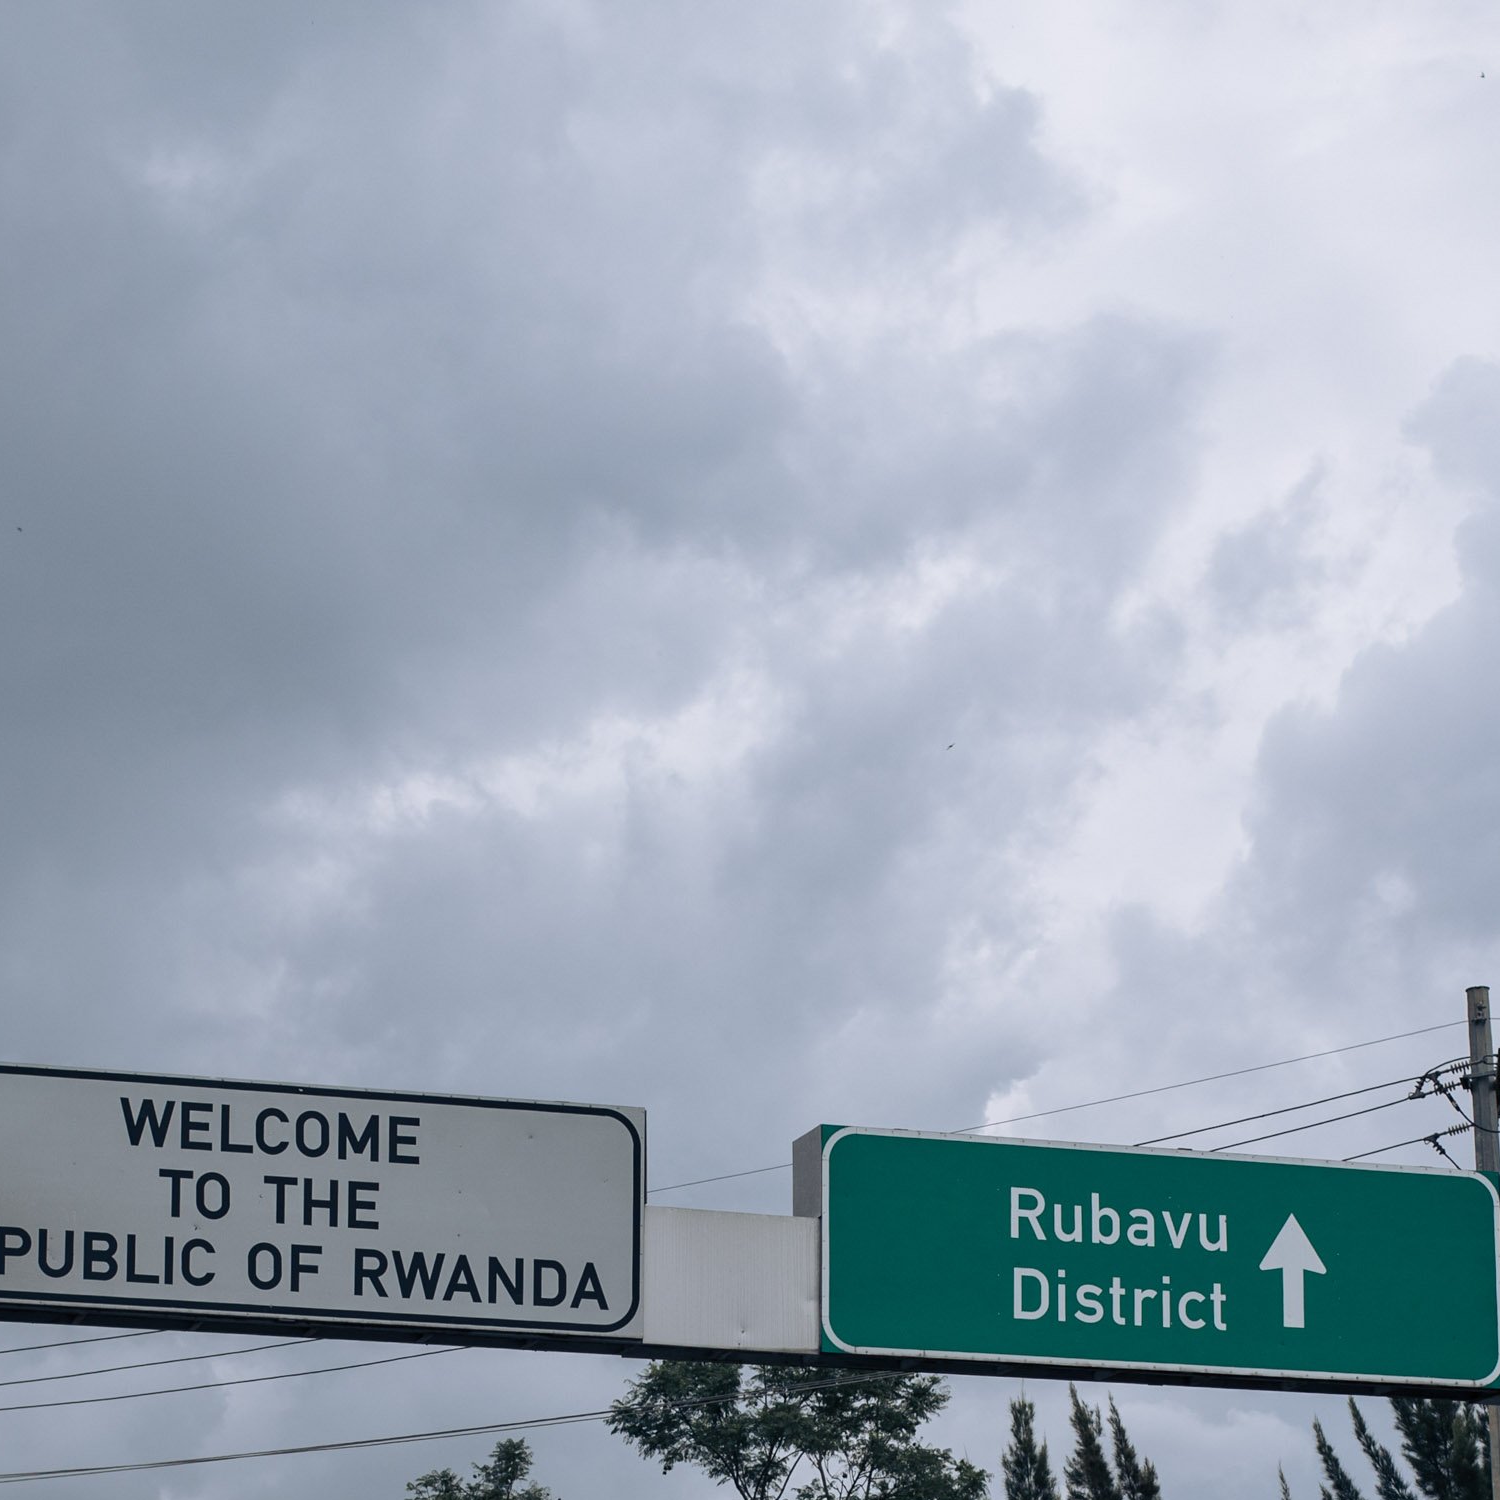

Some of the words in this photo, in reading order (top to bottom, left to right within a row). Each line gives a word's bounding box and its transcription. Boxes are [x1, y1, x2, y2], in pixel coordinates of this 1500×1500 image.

[120, 1096, 420, 1165] WELCOME
[159, 1168, 230, 1220] TO
[264, 1175, 380, 1230] THE
[1010, 1187, 1228, 1252] Rubavu
[247, 1241, 319, 1293] OF
[354, 1248, 608, 1311] RWANDA
[1013, 1267, 1227, 1331] District
